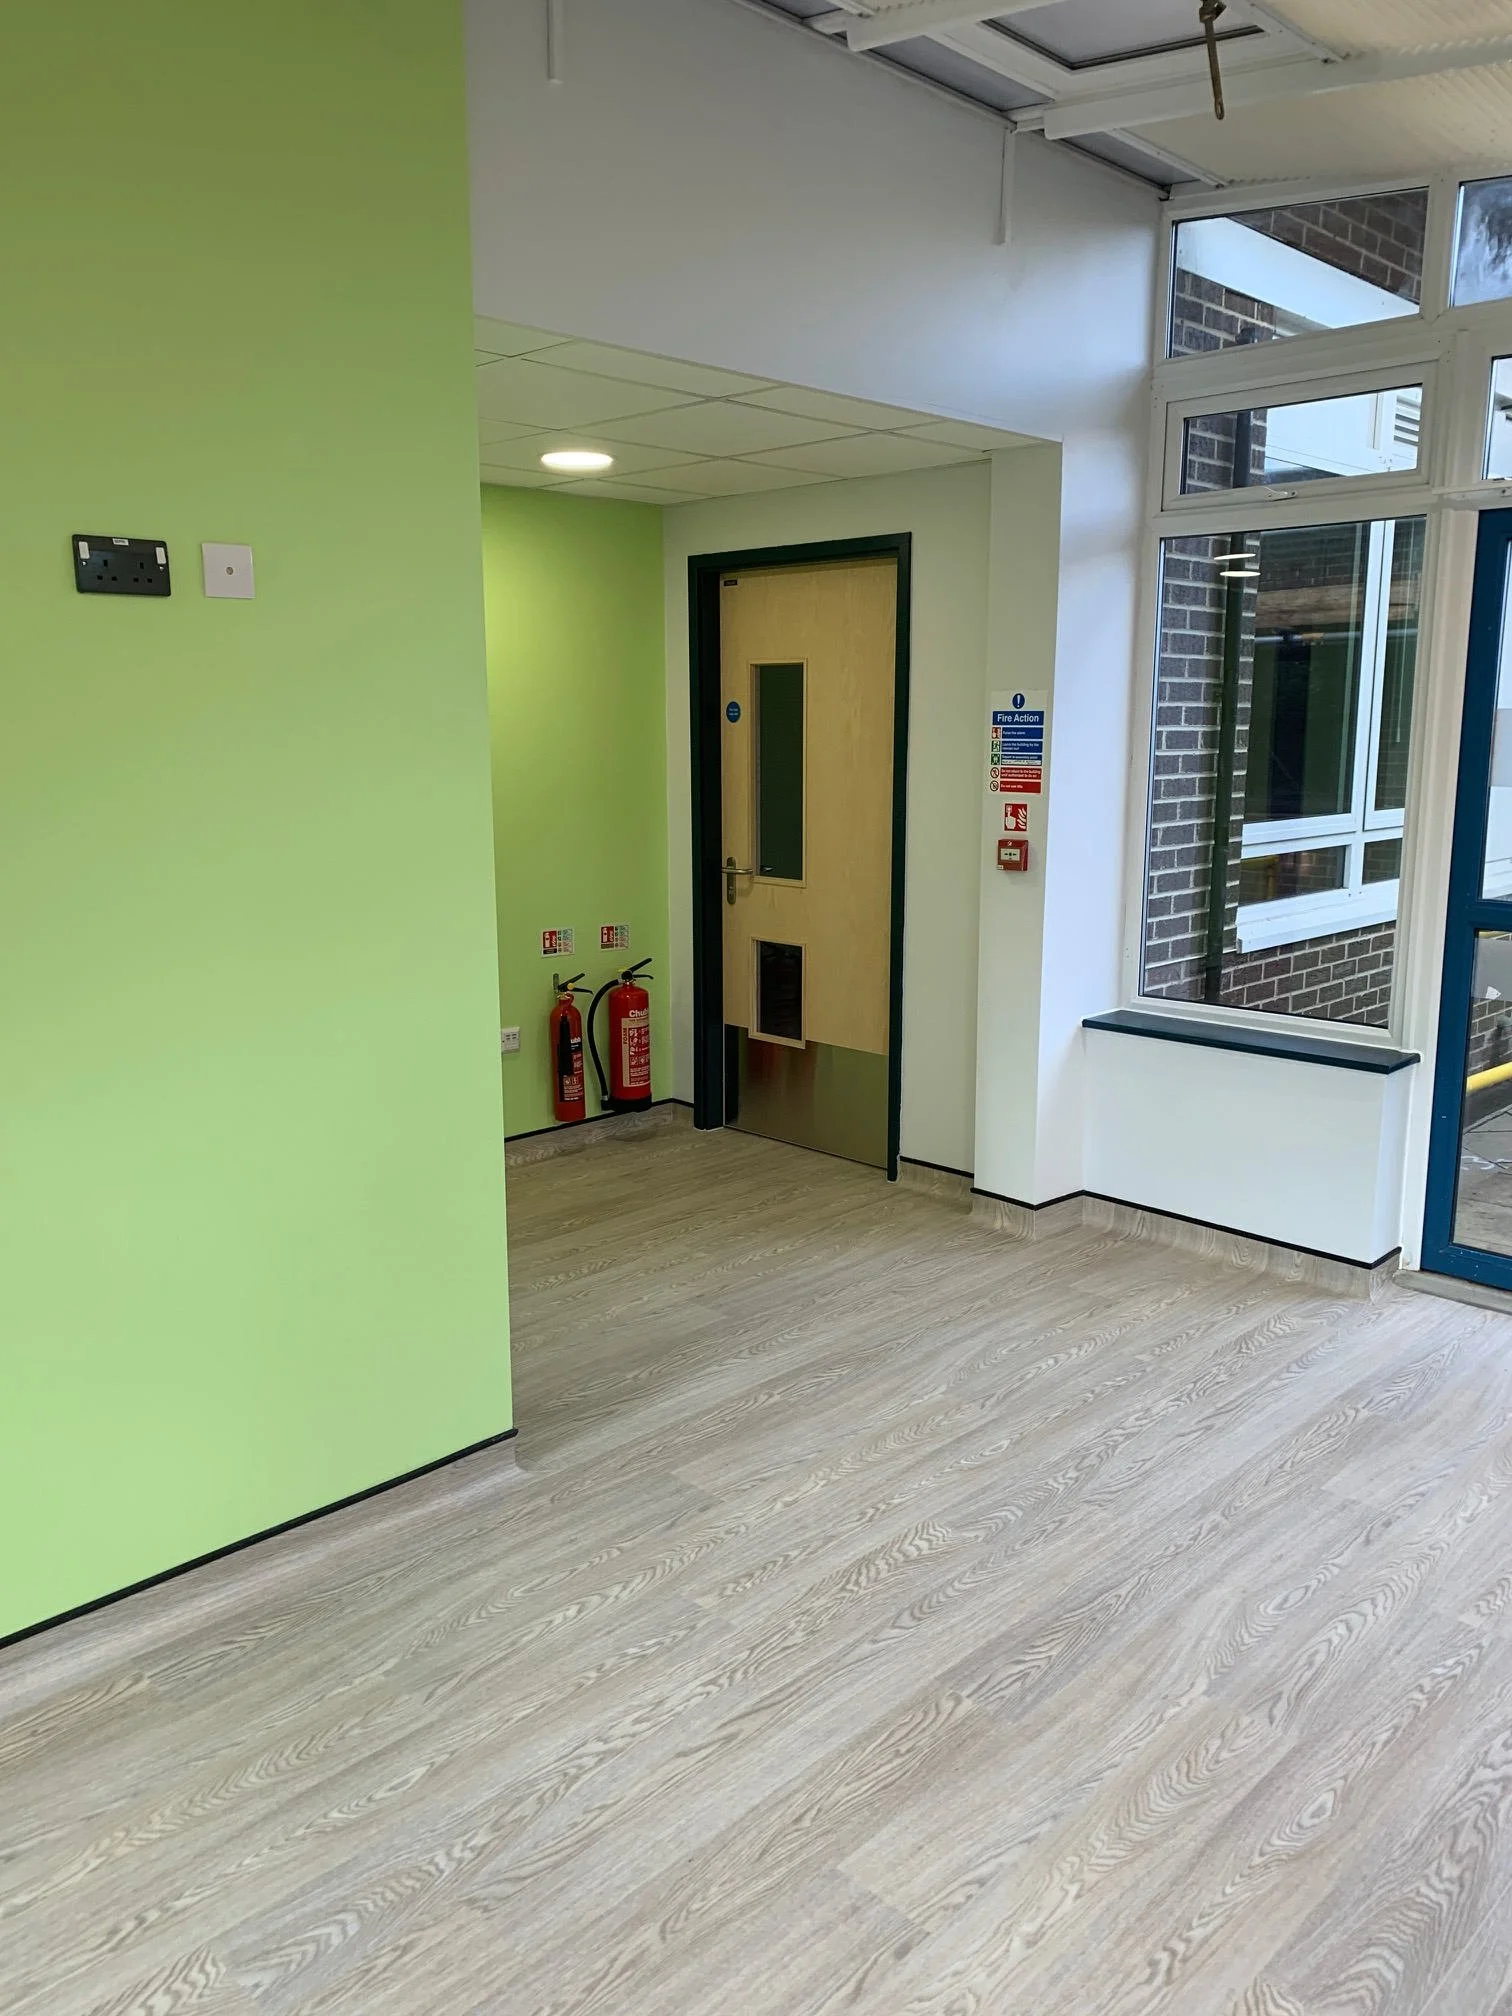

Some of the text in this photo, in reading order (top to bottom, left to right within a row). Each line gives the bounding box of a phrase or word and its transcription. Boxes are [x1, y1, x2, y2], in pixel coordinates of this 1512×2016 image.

[997, 714, 1039, 723] Fire Action
[629, 1007, 648, 1018] Chub
